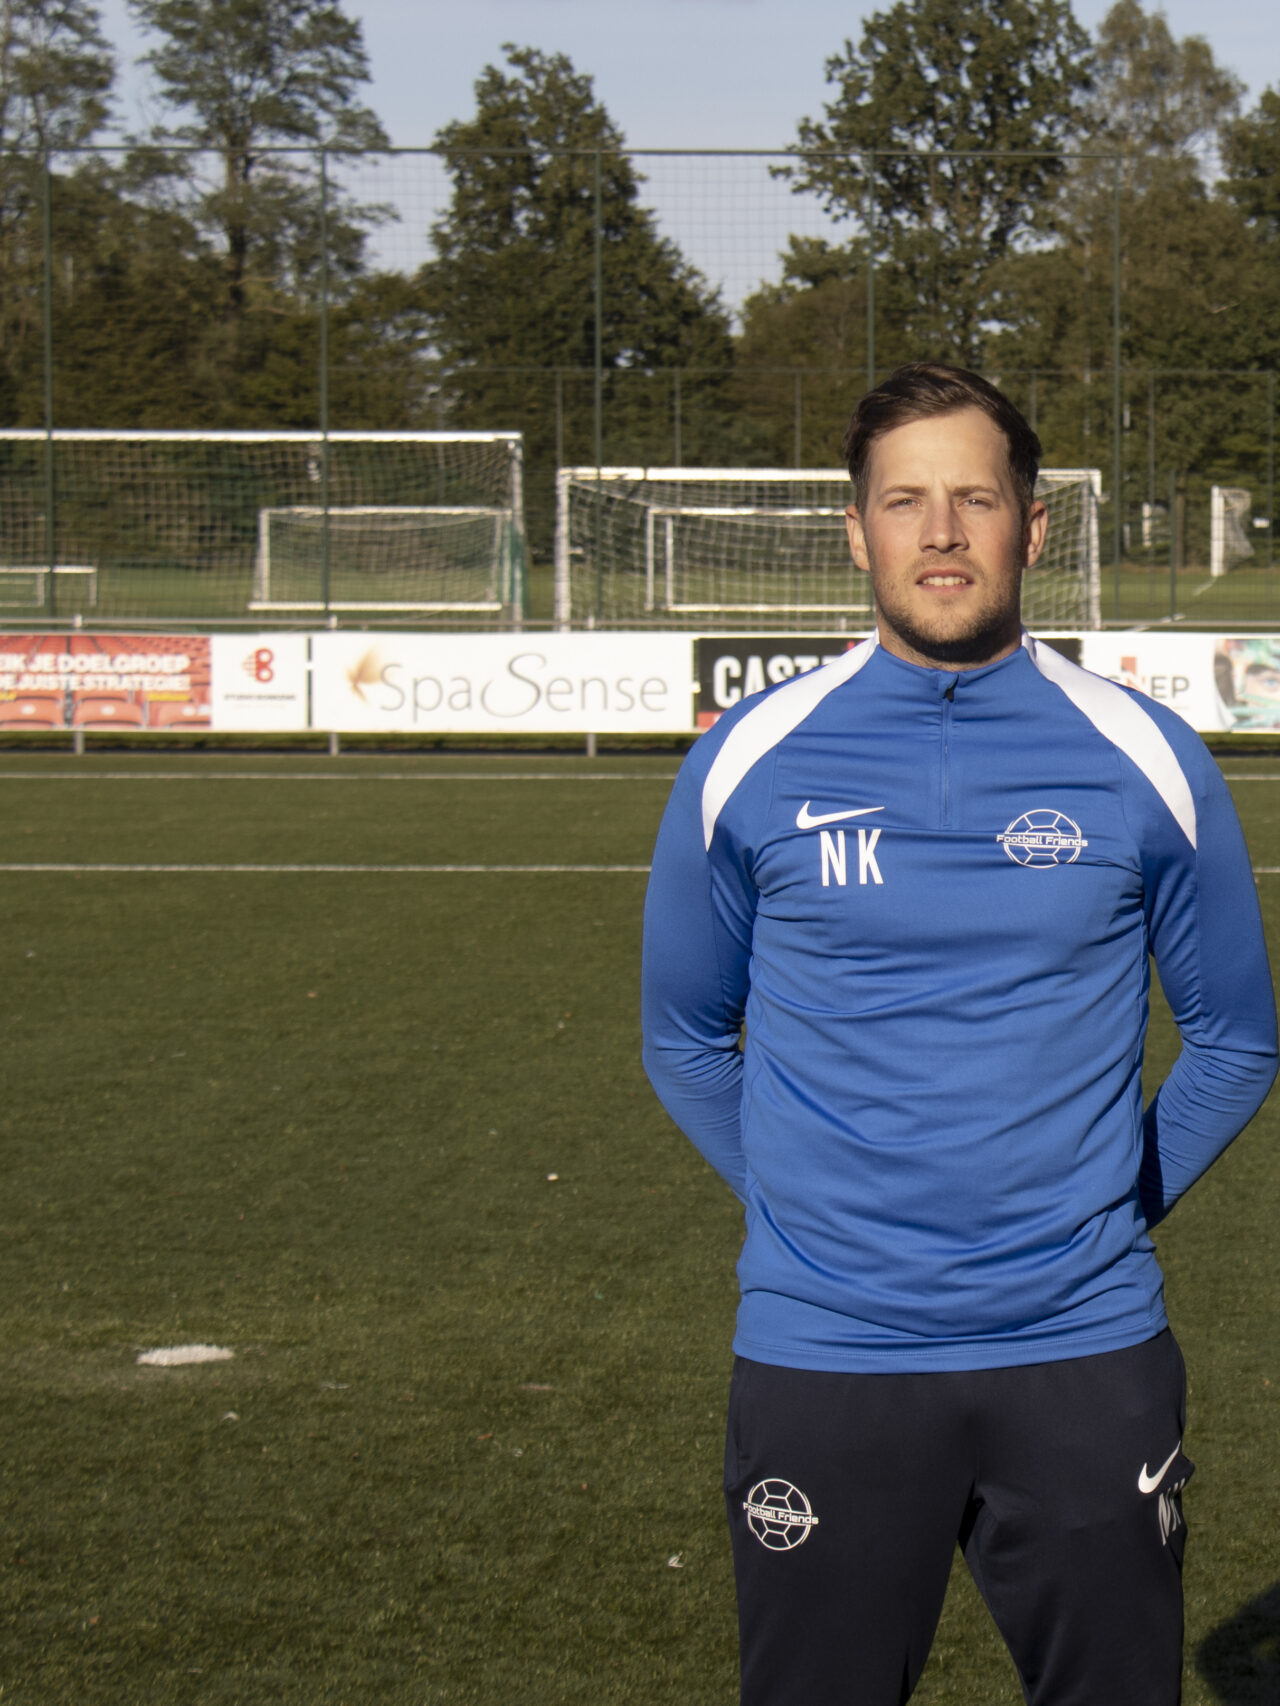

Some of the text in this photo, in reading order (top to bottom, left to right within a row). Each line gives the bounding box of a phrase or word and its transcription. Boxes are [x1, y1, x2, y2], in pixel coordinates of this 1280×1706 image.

[29, 653, 56, 672] JE
[57, 653, 190, 673] DOELGROEP
[713, 655, 842, 708] CAS
[1106, 674, 1190, 699] NEP
[996, 834, 1088, 847] Football Friends
[820, 829, 884, 887] NK
[742, 1501, 819, 1525] Football Friends
